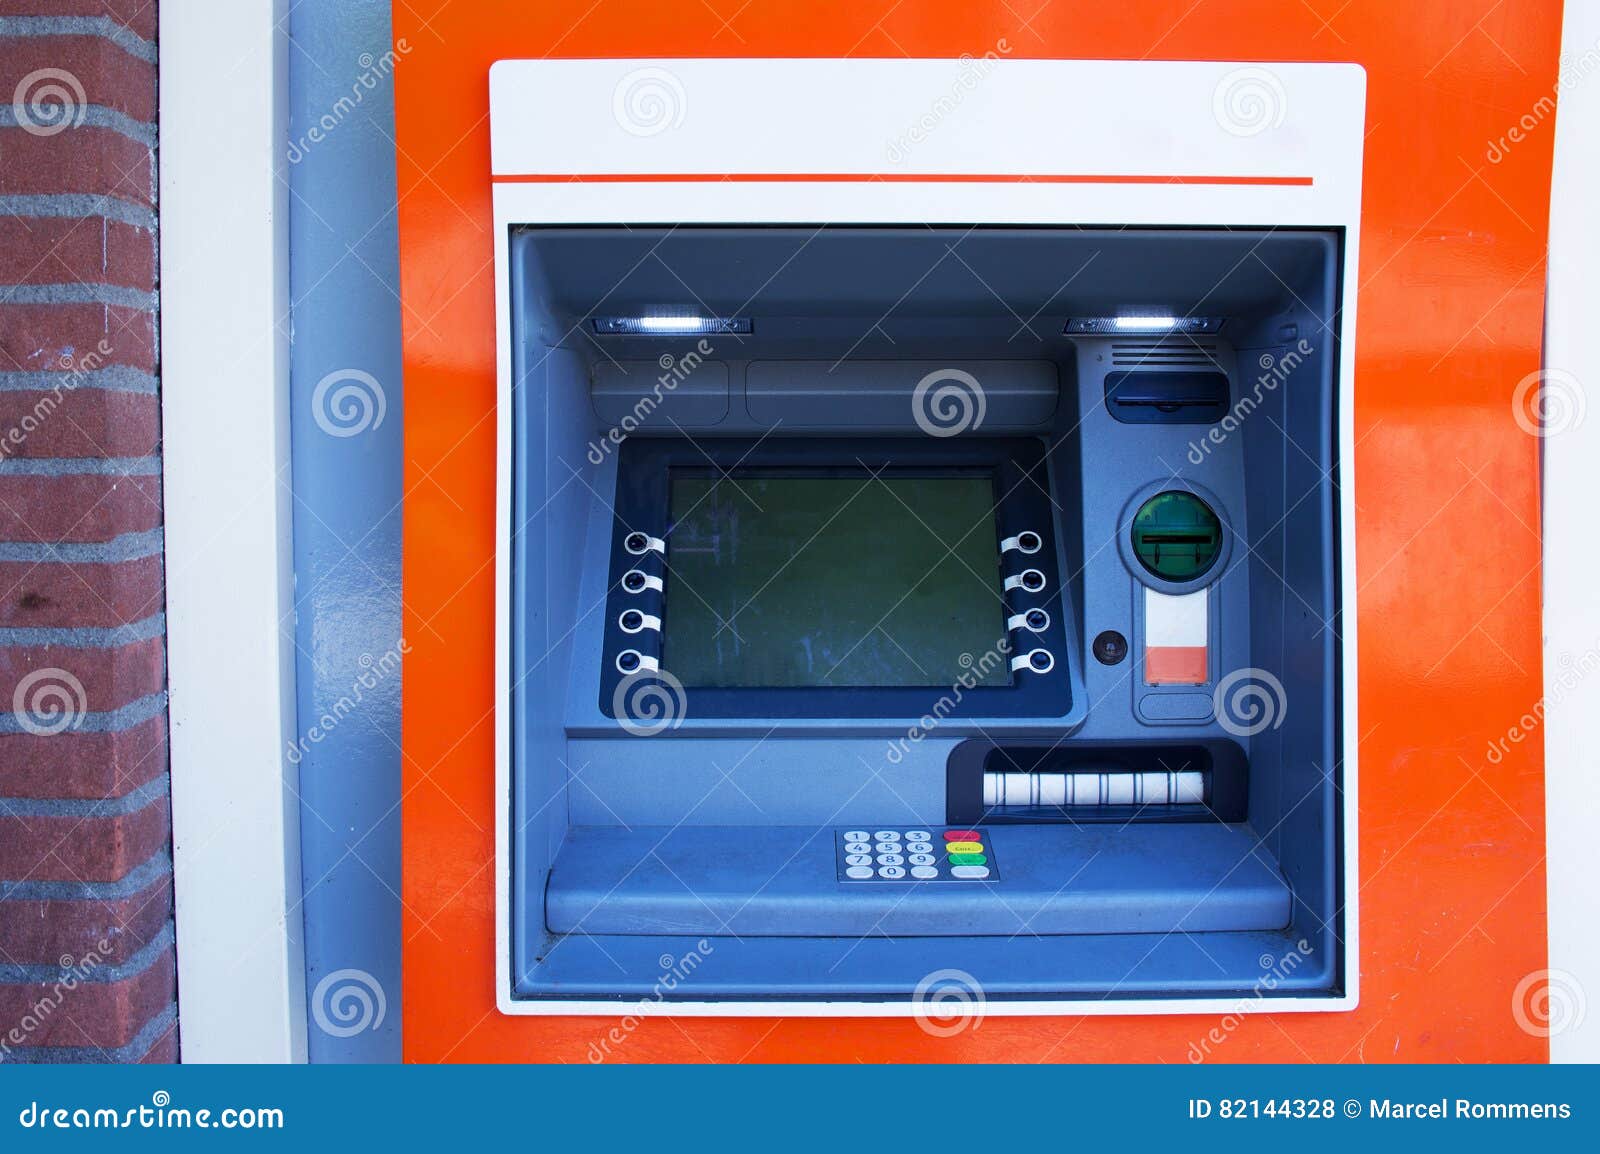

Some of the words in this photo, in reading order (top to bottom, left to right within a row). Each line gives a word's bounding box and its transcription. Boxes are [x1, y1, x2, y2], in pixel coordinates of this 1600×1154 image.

[853, 844, 862, 852] 4
[854, 855, 864, 863] 7
[886, 855, 895, 863] 8
[917, 855, 926, 863] 9
[886, 867, 897, 875] 0
